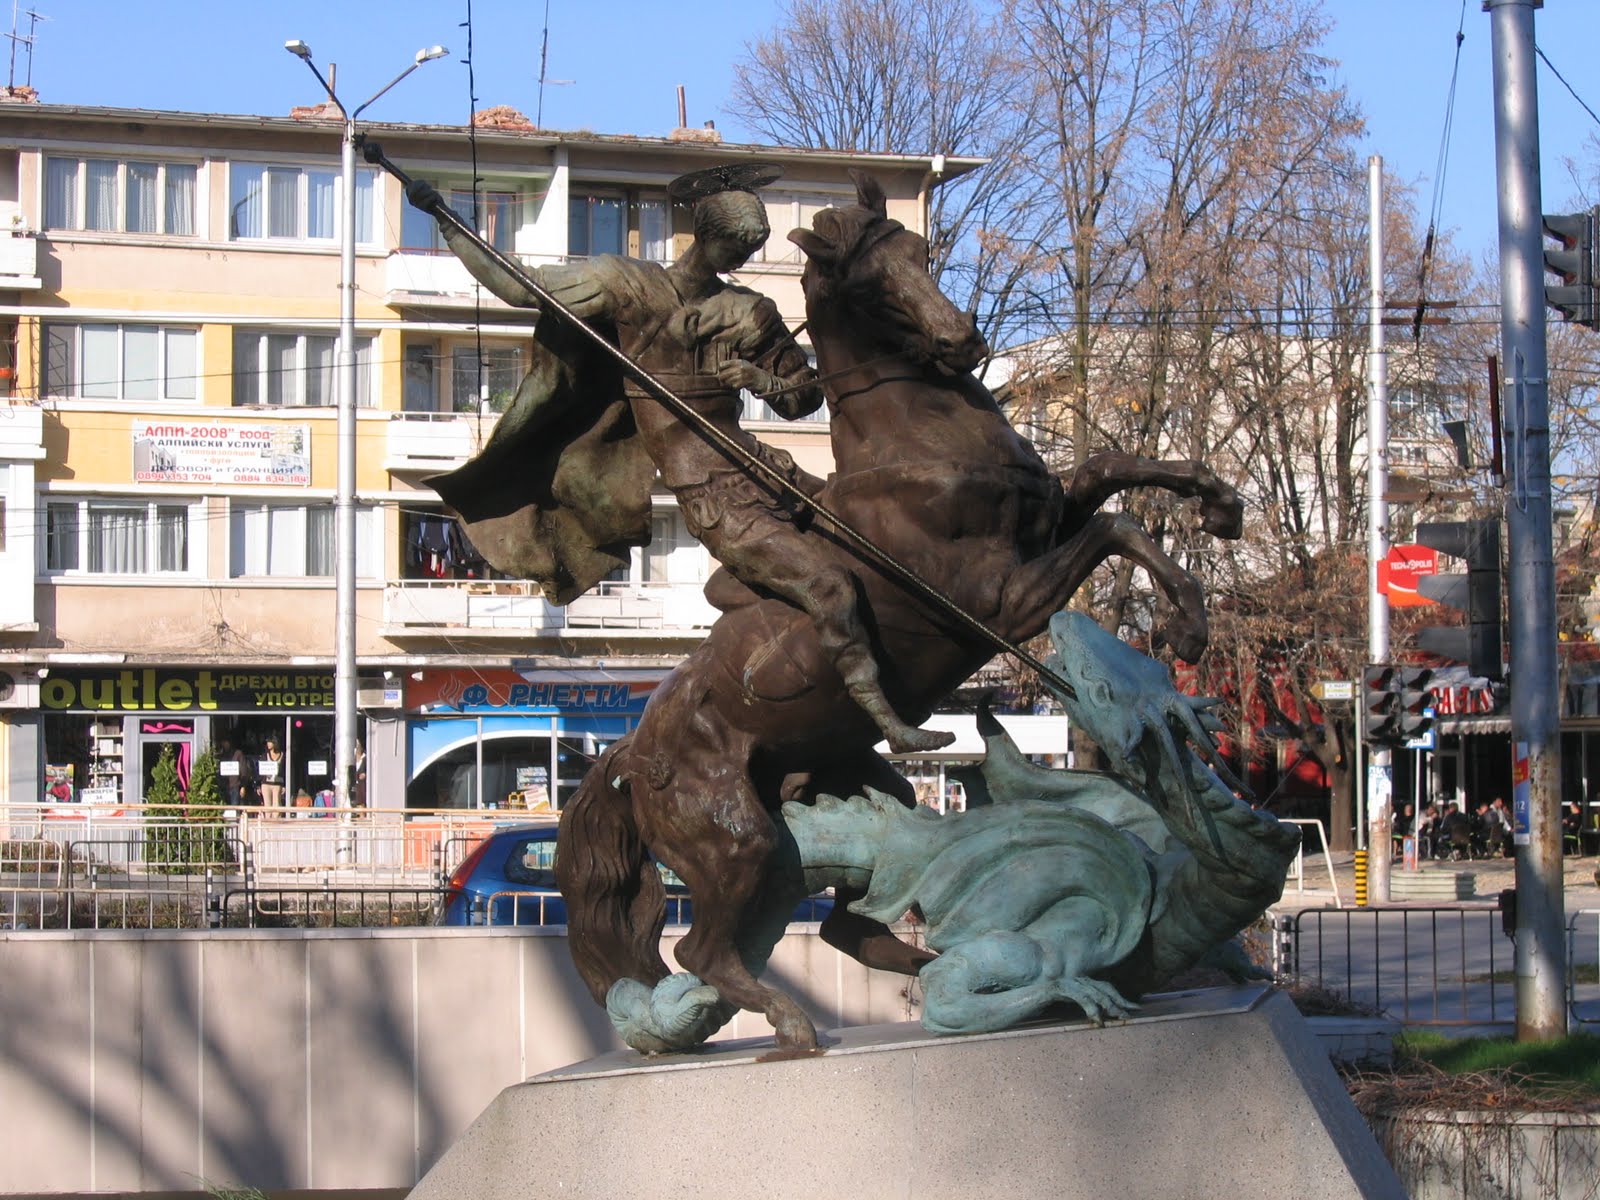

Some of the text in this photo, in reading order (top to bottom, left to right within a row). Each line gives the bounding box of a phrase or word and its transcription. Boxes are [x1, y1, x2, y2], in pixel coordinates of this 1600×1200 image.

[158, 439, 271, 449] АЛПИЙСКИ УСЛУГИ
[40, 669, 219, 710] outlet
[219, 675, 335, 691] ДРЕХИ ВТО
[254, 692, 335, 706] УПОТРЕ
[462, 683, 631, 707] ФОРНЕТТИ
